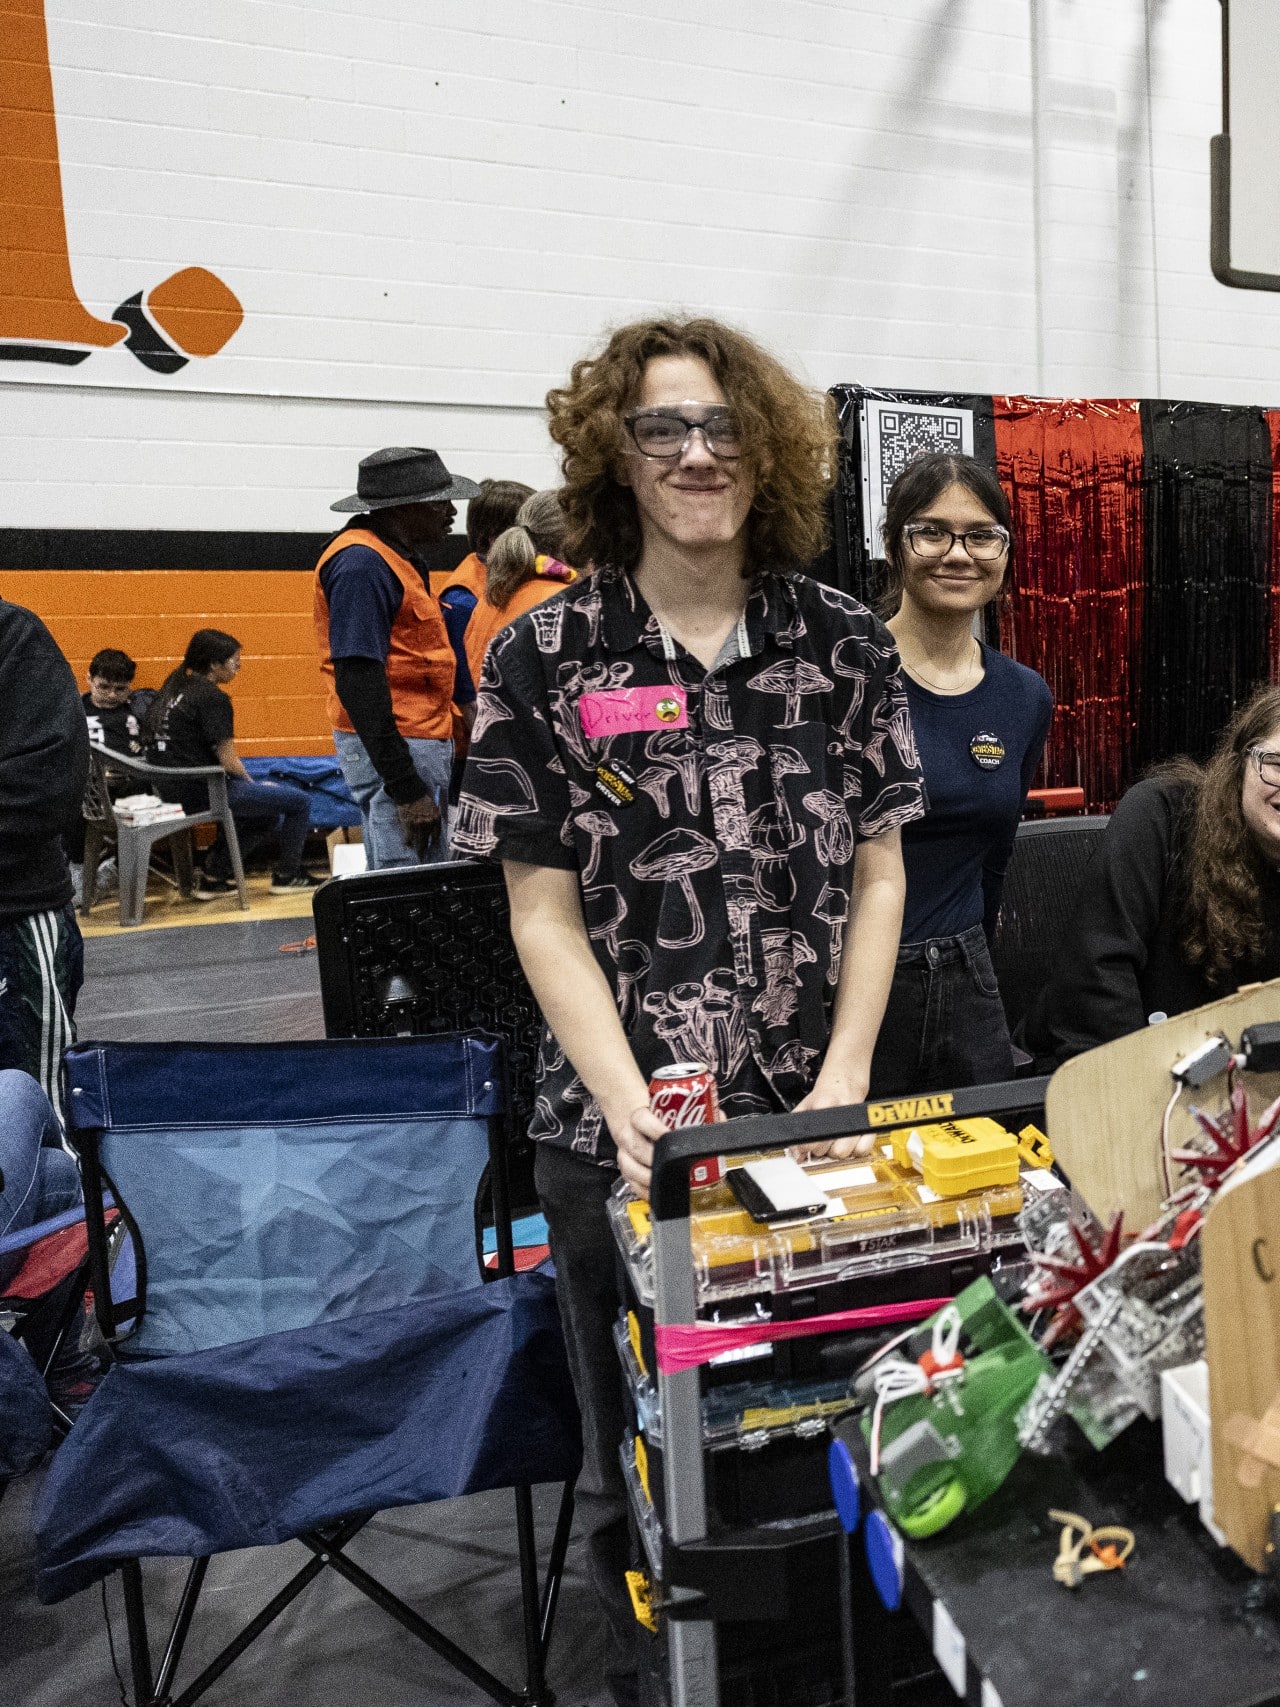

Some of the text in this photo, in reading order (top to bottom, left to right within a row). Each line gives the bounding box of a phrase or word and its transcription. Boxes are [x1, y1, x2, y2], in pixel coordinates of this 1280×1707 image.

[595, 780, 622, 806] DRIVER
[867, 1093, 955, 1127] DEWALT
[938, 1121, 977, 1144] DEWAL
